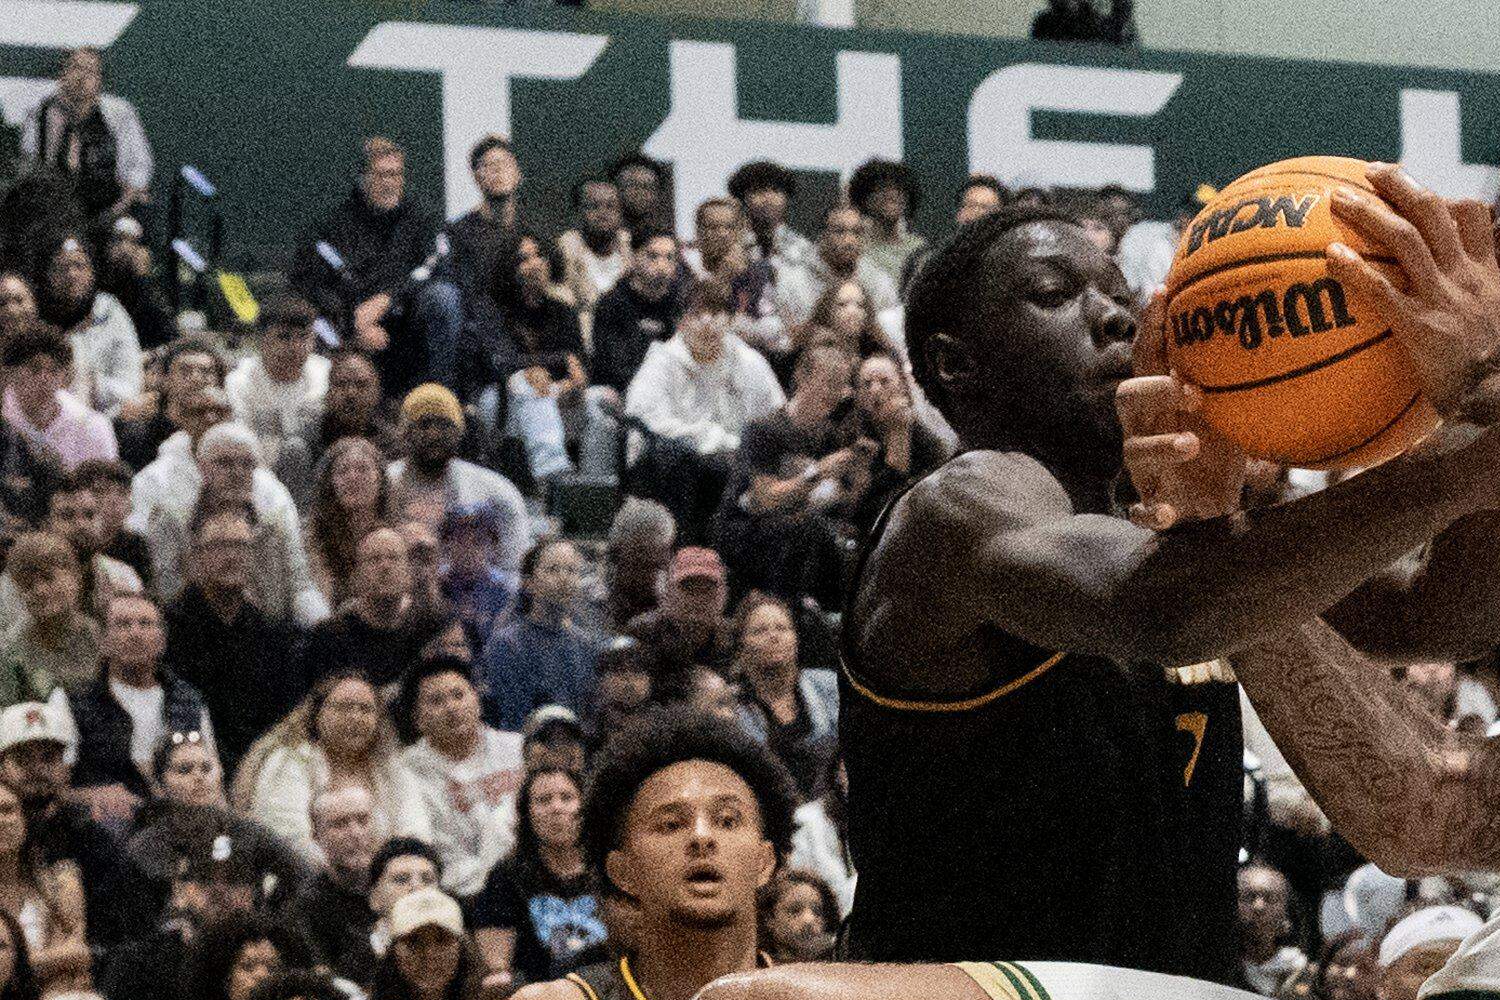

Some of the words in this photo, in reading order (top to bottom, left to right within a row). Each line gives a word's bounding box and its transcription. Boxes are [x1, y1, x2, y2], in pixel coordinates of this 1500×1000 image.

[347, 21, 1184, 245] THE
[1186, 195, 1321, 256] NCAA
[1171, 277, 1357, 350] Wilson
